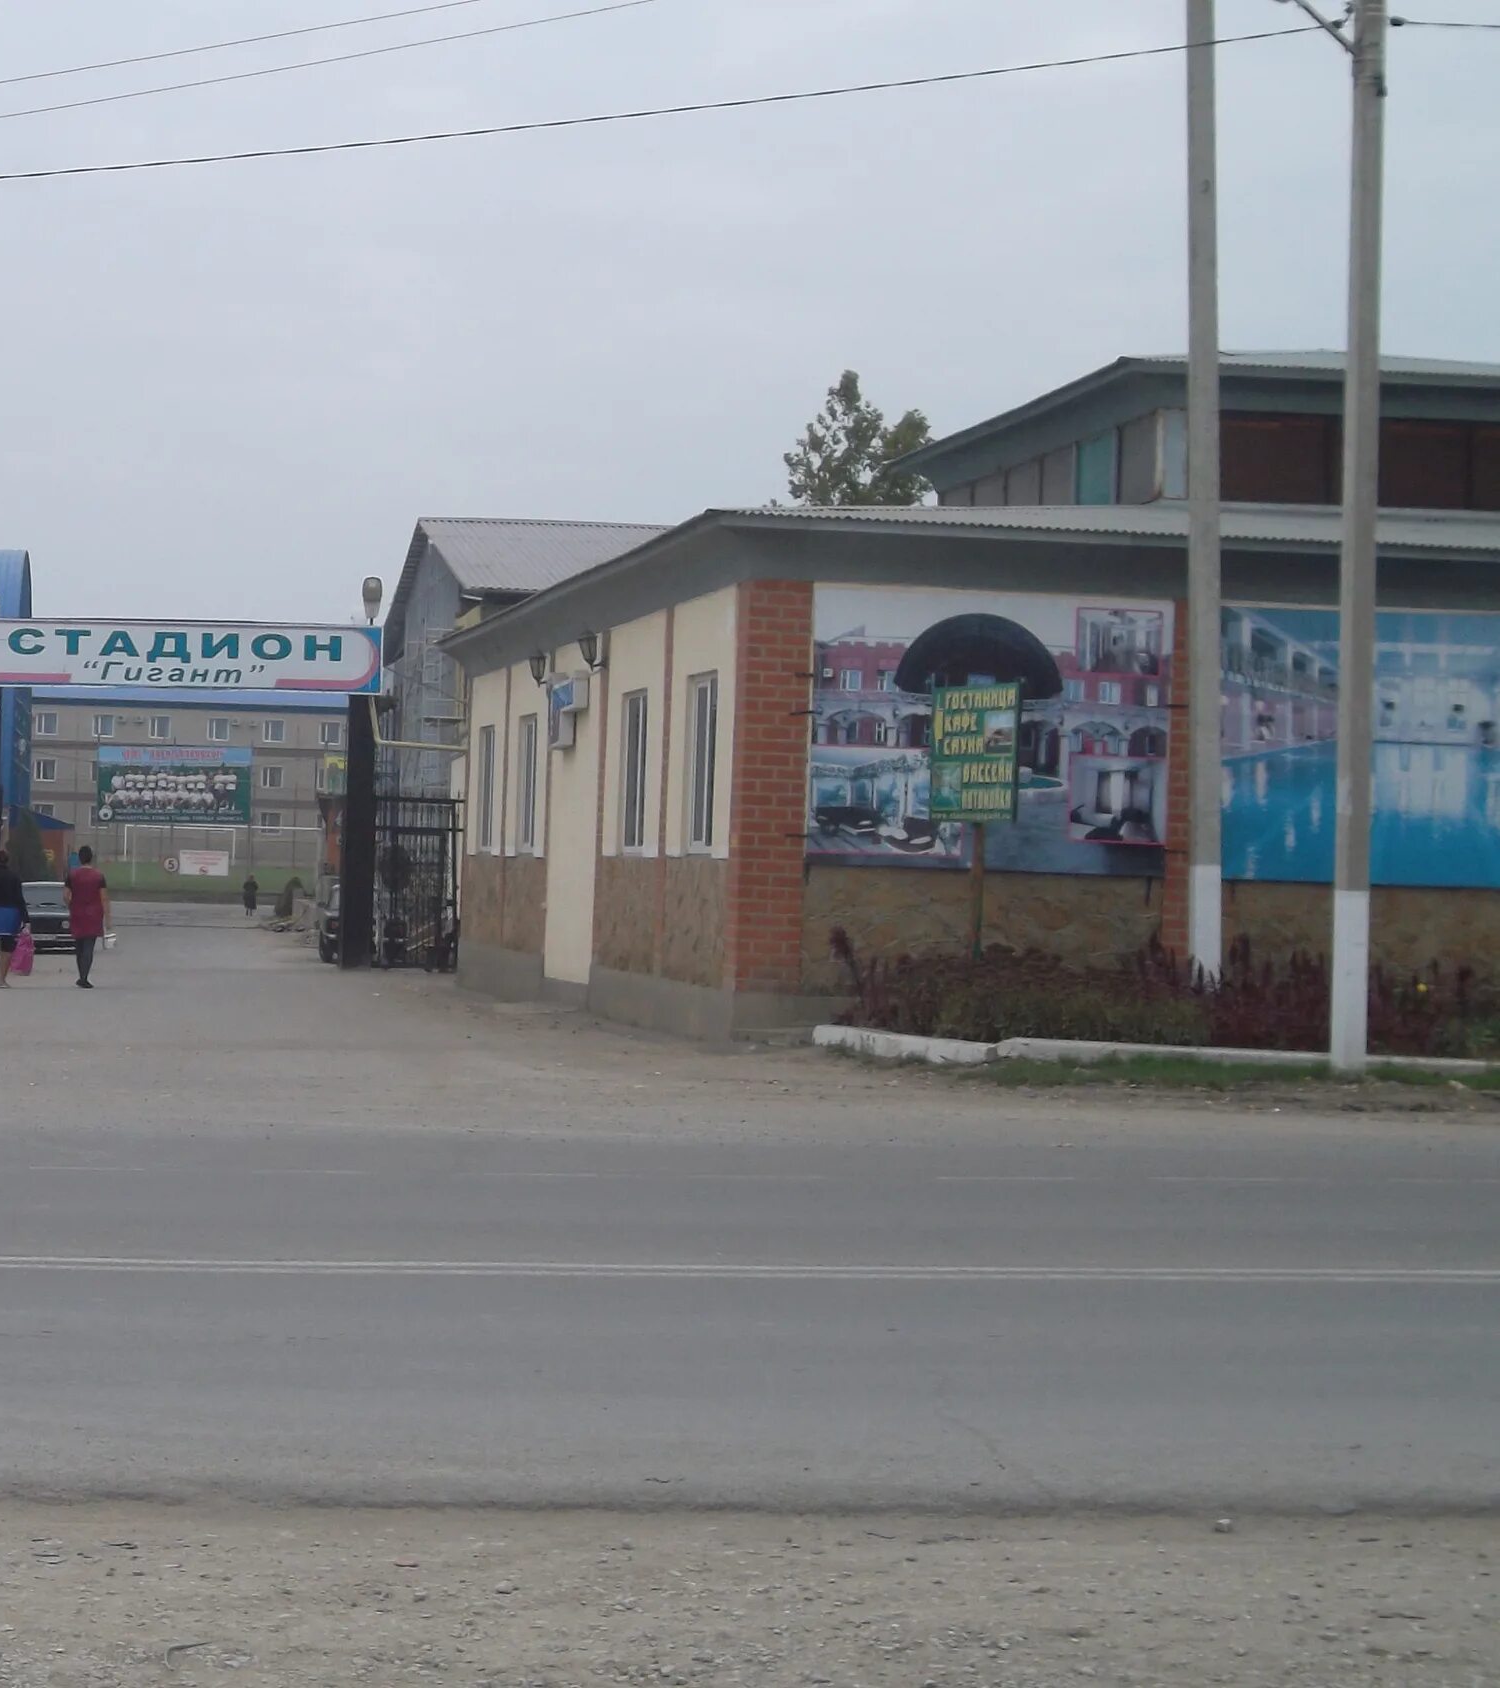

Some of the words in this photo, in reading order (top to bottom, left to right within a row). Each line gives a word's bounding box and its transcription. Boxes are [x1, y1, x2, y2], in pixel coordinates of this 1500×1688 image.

[7, 627, 343, 664] СТАДИОН
[945, 687, 1016, 710] ГОСТИНИЦА
[944, 710, 978, 733] КАФЕ
[943, 736, 985, 756] САУНА
[962, 758, 1013, 783] БАССЕЙН
